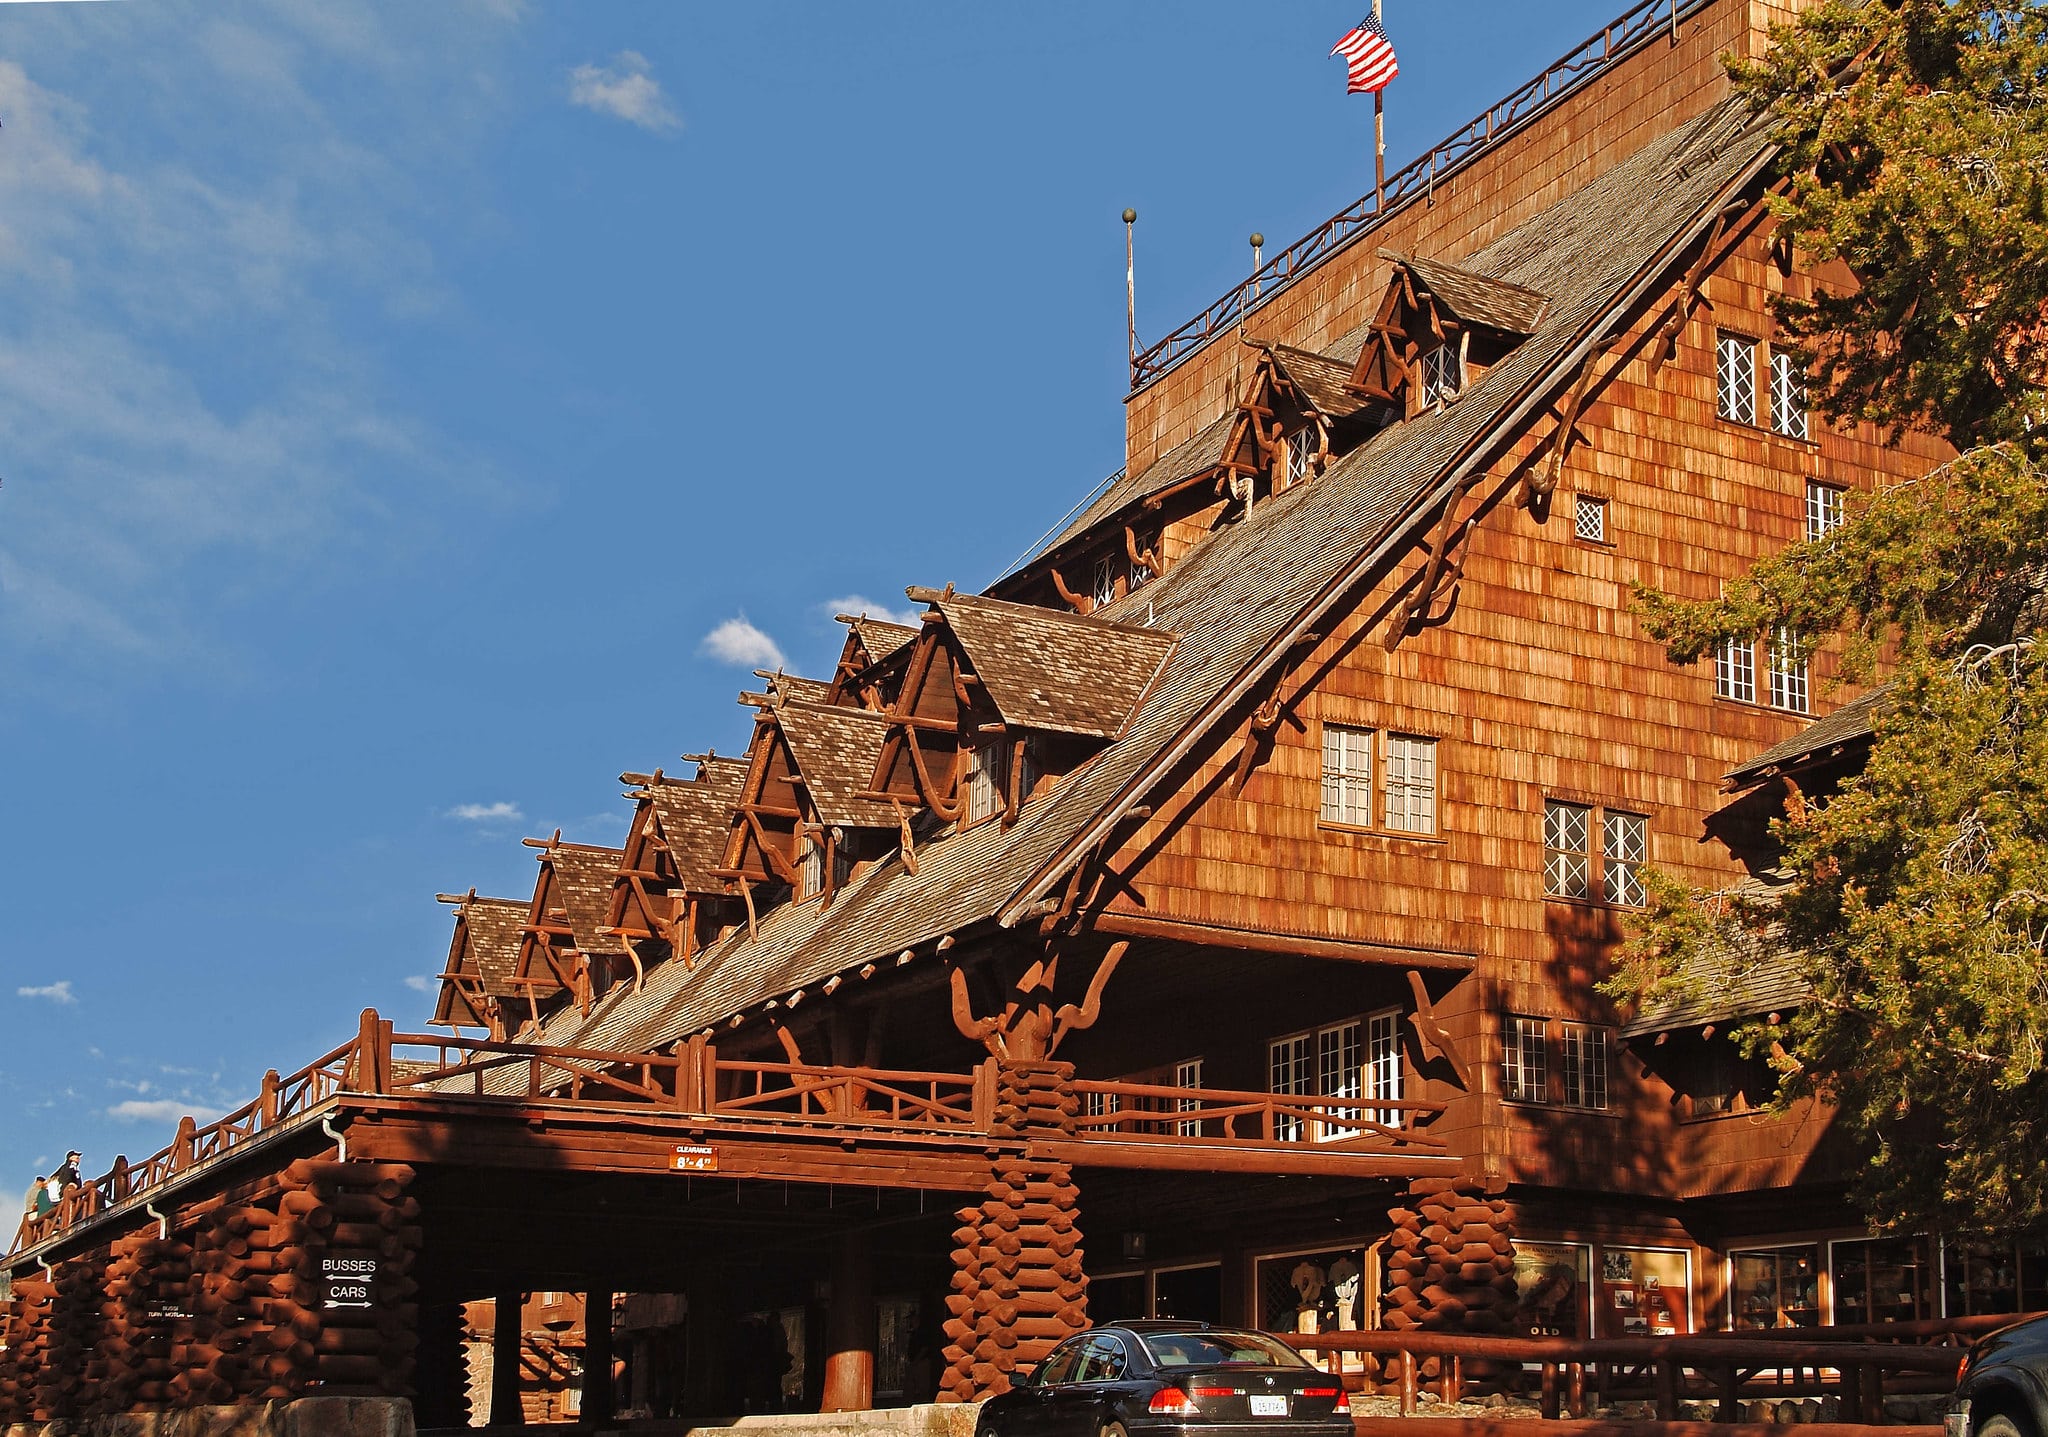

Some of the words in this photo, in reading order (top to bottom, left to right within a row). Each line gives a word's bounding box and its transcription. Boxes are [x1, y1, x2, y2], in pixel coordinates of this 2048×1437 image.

[676, 1145, 713, 1154] CLEARANCE
[322, 1259, 376, 1272] BUSSES
[330, 1286, 367, 1298] CARS
[1530, 1326, 1560, 1336] OLD
